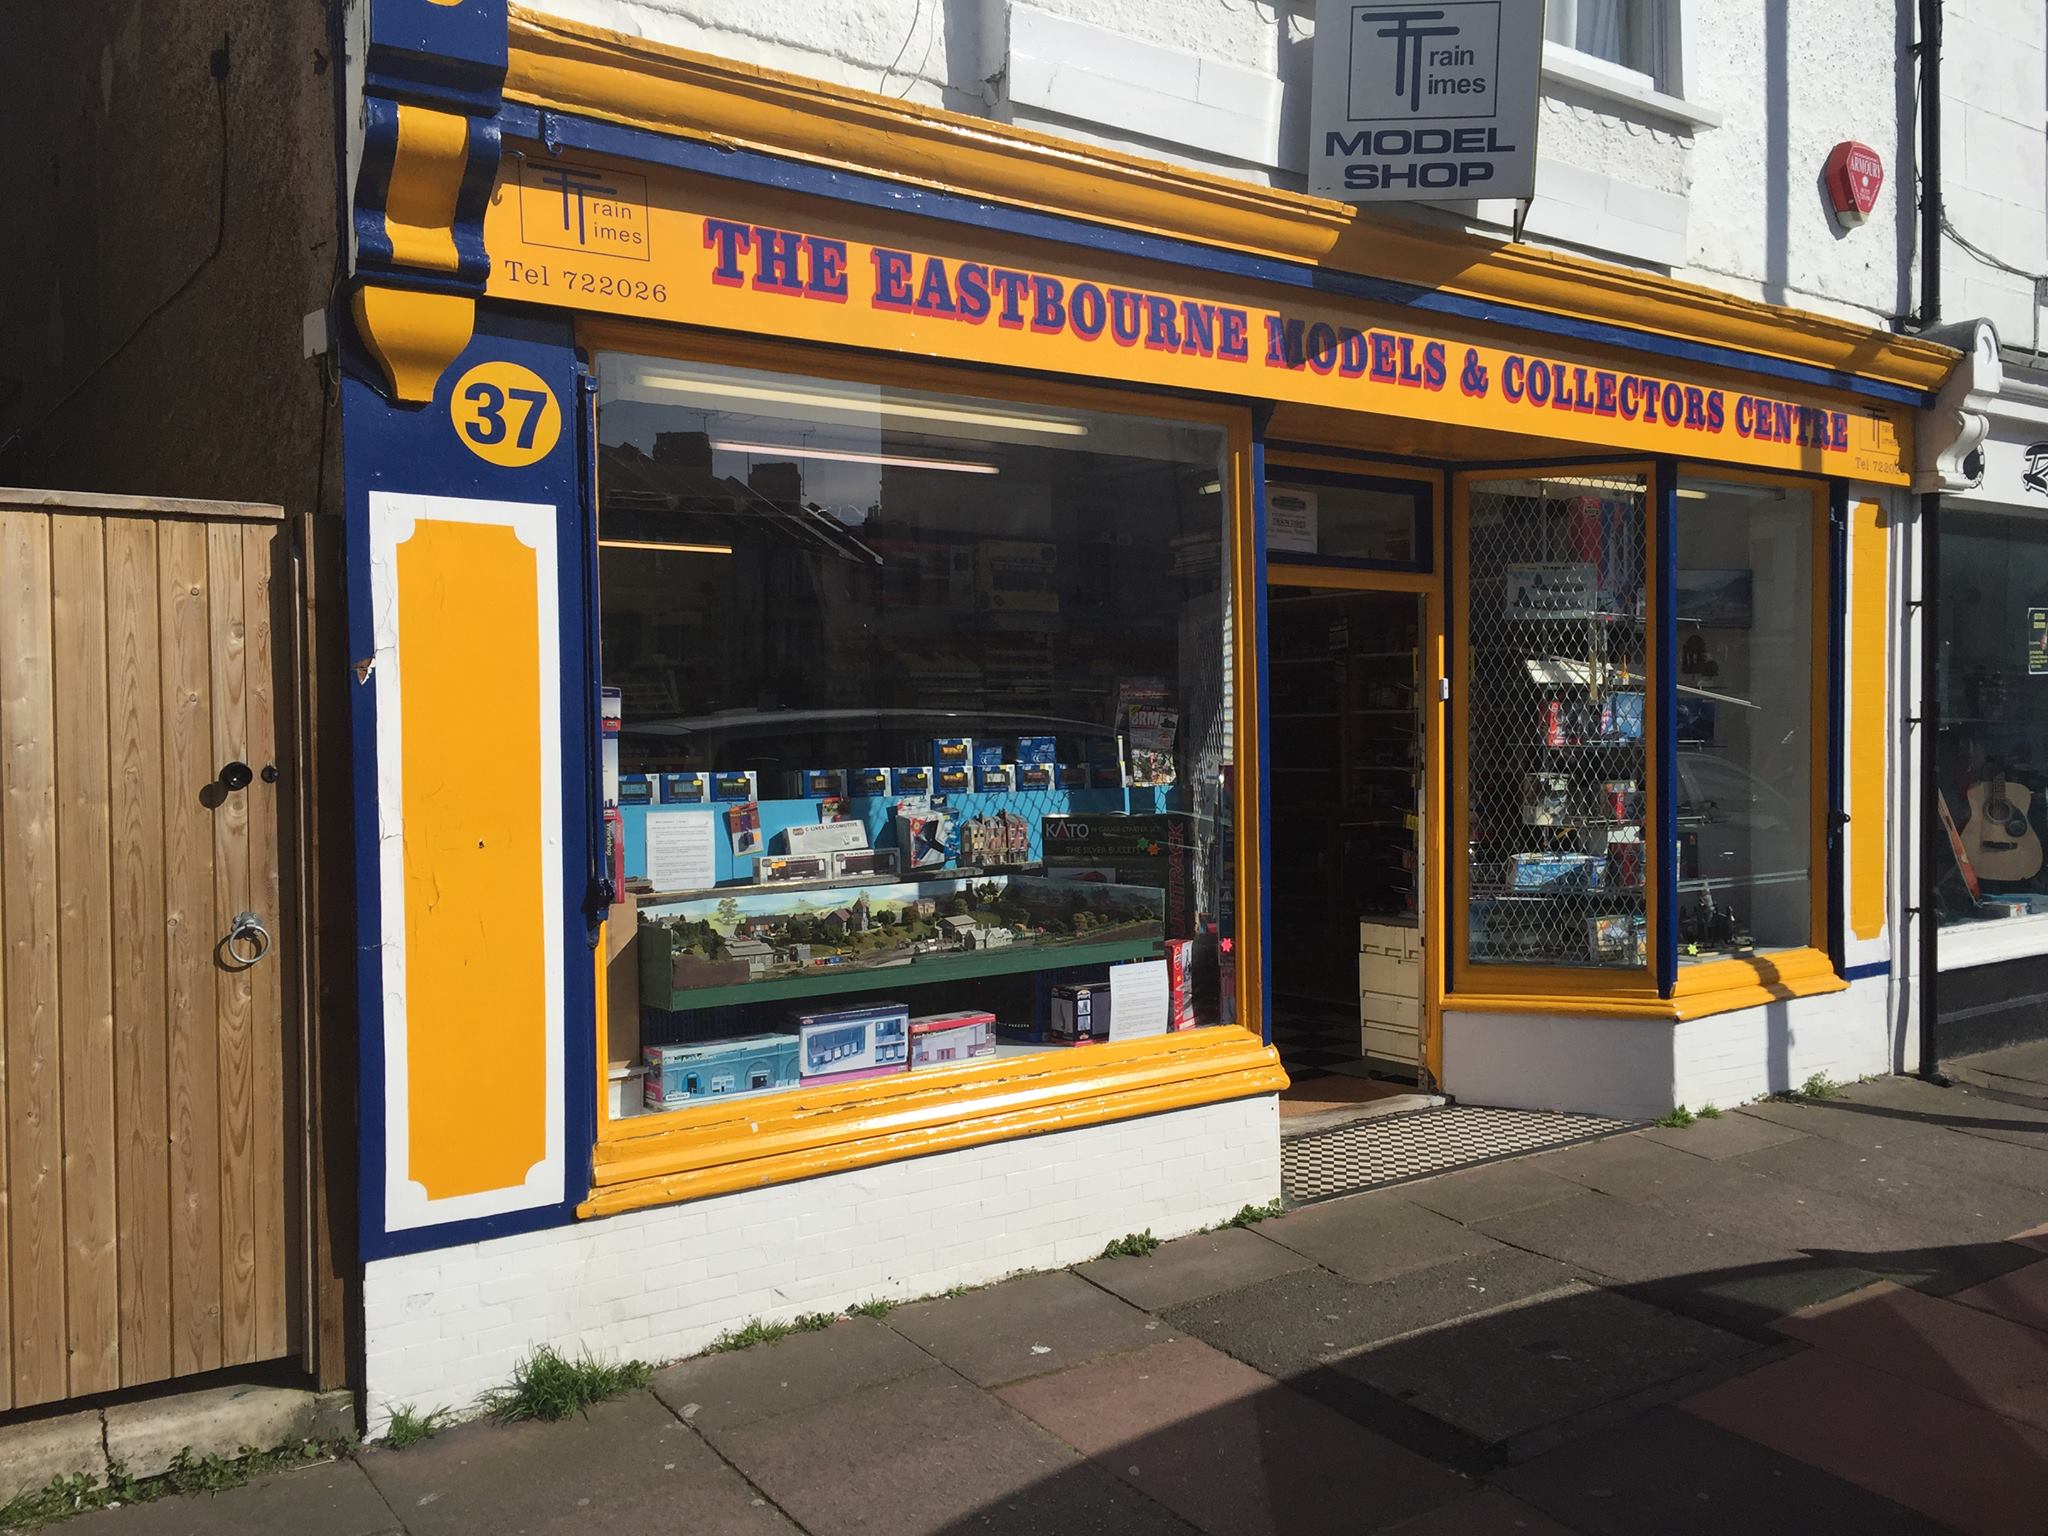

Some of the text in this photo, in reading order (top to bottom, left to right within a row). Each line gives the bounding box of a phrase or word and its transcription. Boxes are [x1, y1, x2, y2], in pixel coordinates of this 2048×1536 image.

[1325, 127, 1516, 157] MODEL
[1343, 161, 1494, 190] SHOP
[504, 260, 668, 304] Tel 722026
[702, 216, 1849, 453] THE EASTBOURNE MODELS & COLLECTORS CENTRE
[464, 382, 548, 450] 37
[1855, 456, 1869, 472] Tel
[1045, 818, 1089, 839] KATO
